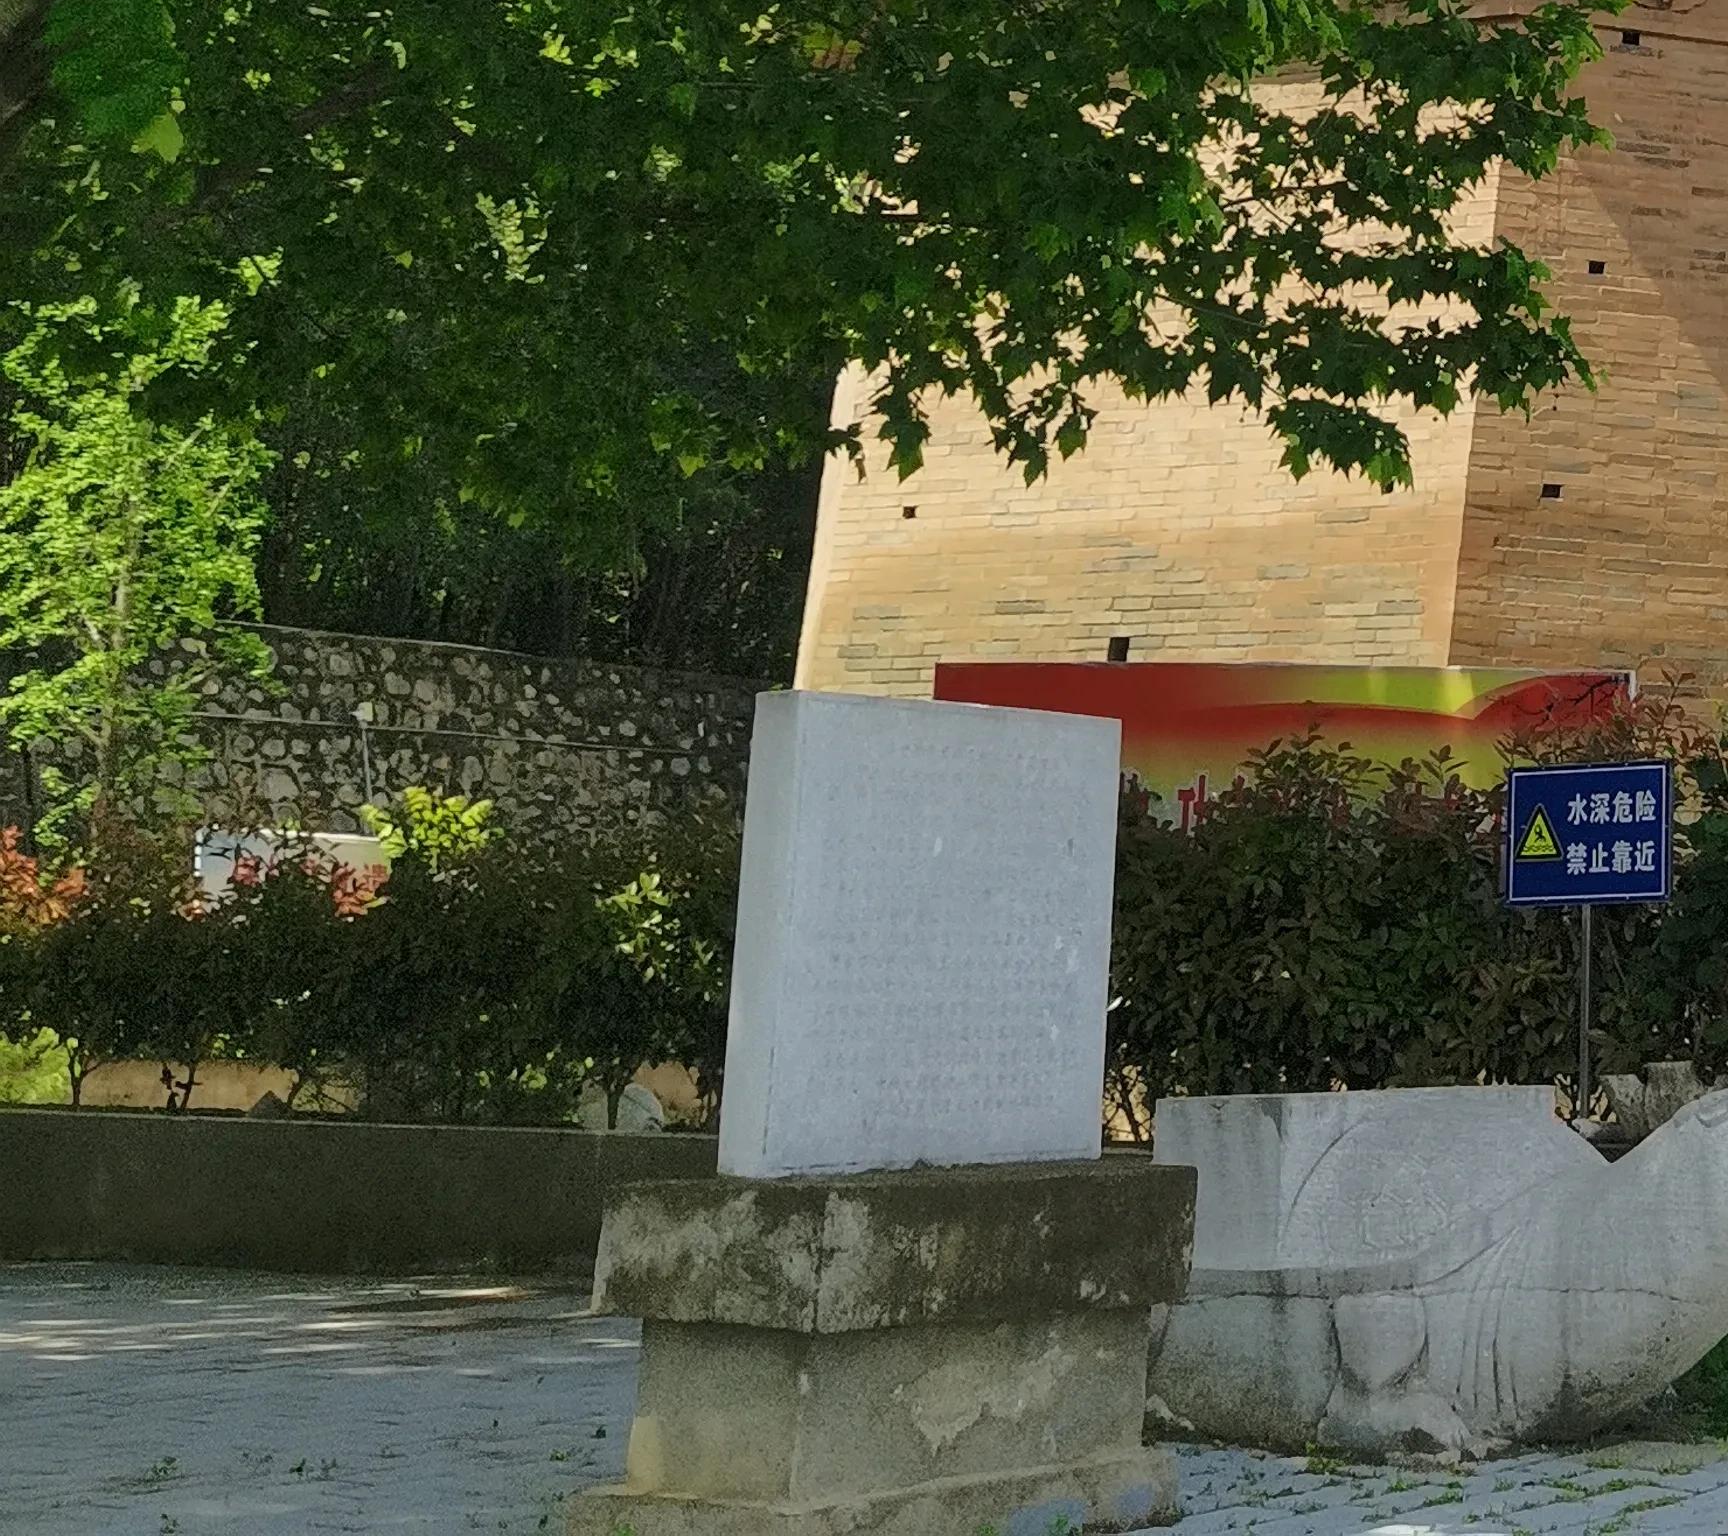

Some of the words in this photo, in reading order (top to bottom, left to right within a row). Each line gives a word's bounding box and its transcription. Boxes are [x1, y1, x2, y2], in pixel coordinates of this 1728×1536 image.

[1567, 789, 1657, 825] 水深危险
[1566, 840, 1656, 875] 禁止靠近
